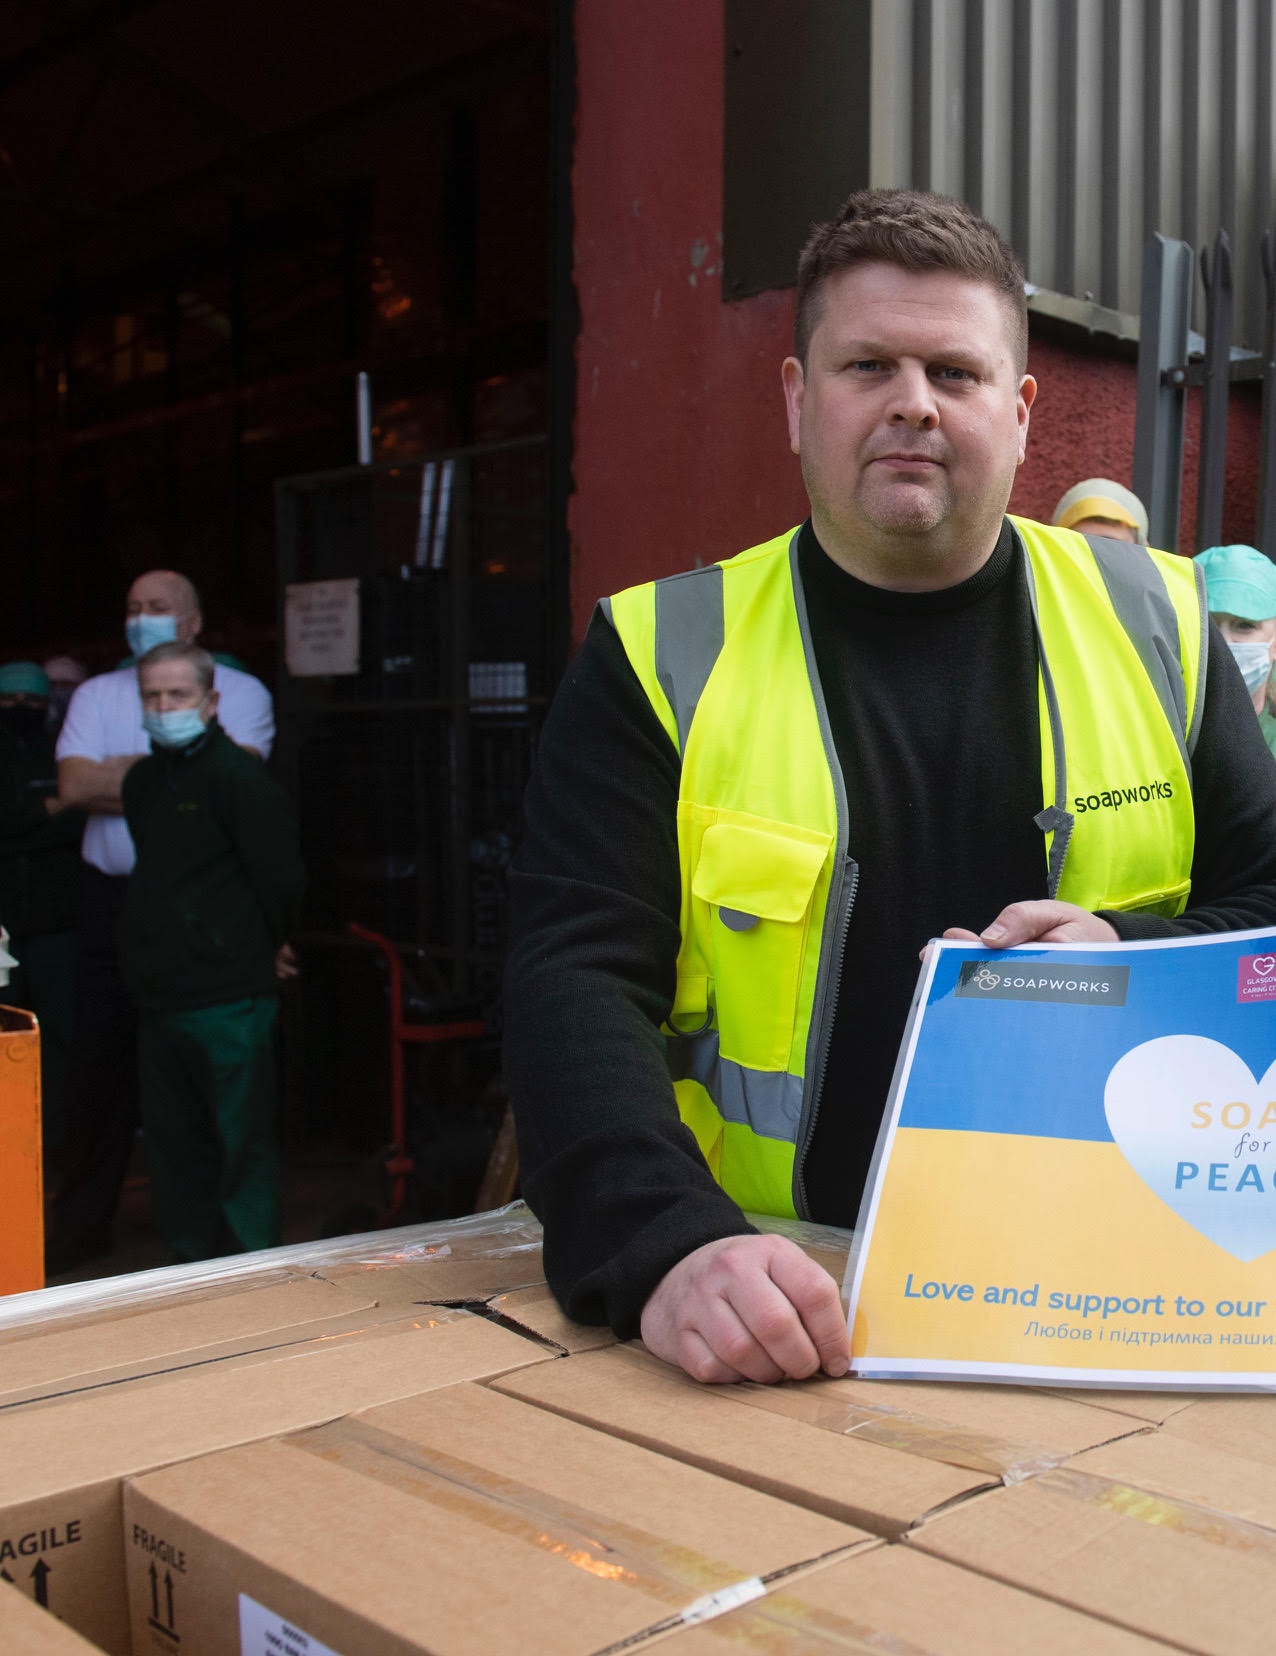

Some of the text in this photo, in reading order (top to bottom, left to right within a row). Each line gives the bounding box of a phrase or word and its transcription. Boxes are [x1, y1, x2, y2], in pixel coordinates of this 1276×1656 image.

[1074, 780, 1173, 813] soapworks
[1003, 977, 1110, 993] SOAPWORKS
[1243, 986, 1268, 995] CARING
[1234, 1132, 1272, 1158] for
[904, 1274, 975, 1301] Love
[983, 1284, 1040, 1307] and
[1048, 1290, 1165, 1319] support
[1174, 1296, 1205, 1317] to
[1215, 1299, 1267, 1318] our
[1024, 1321, 1093, 1341] Любов
[1110, 1328, 1213, 1347] підтримка
[0, 1520, 82, 1564] AGILE
[133, 1523, 187, 1574] FRAGILE
